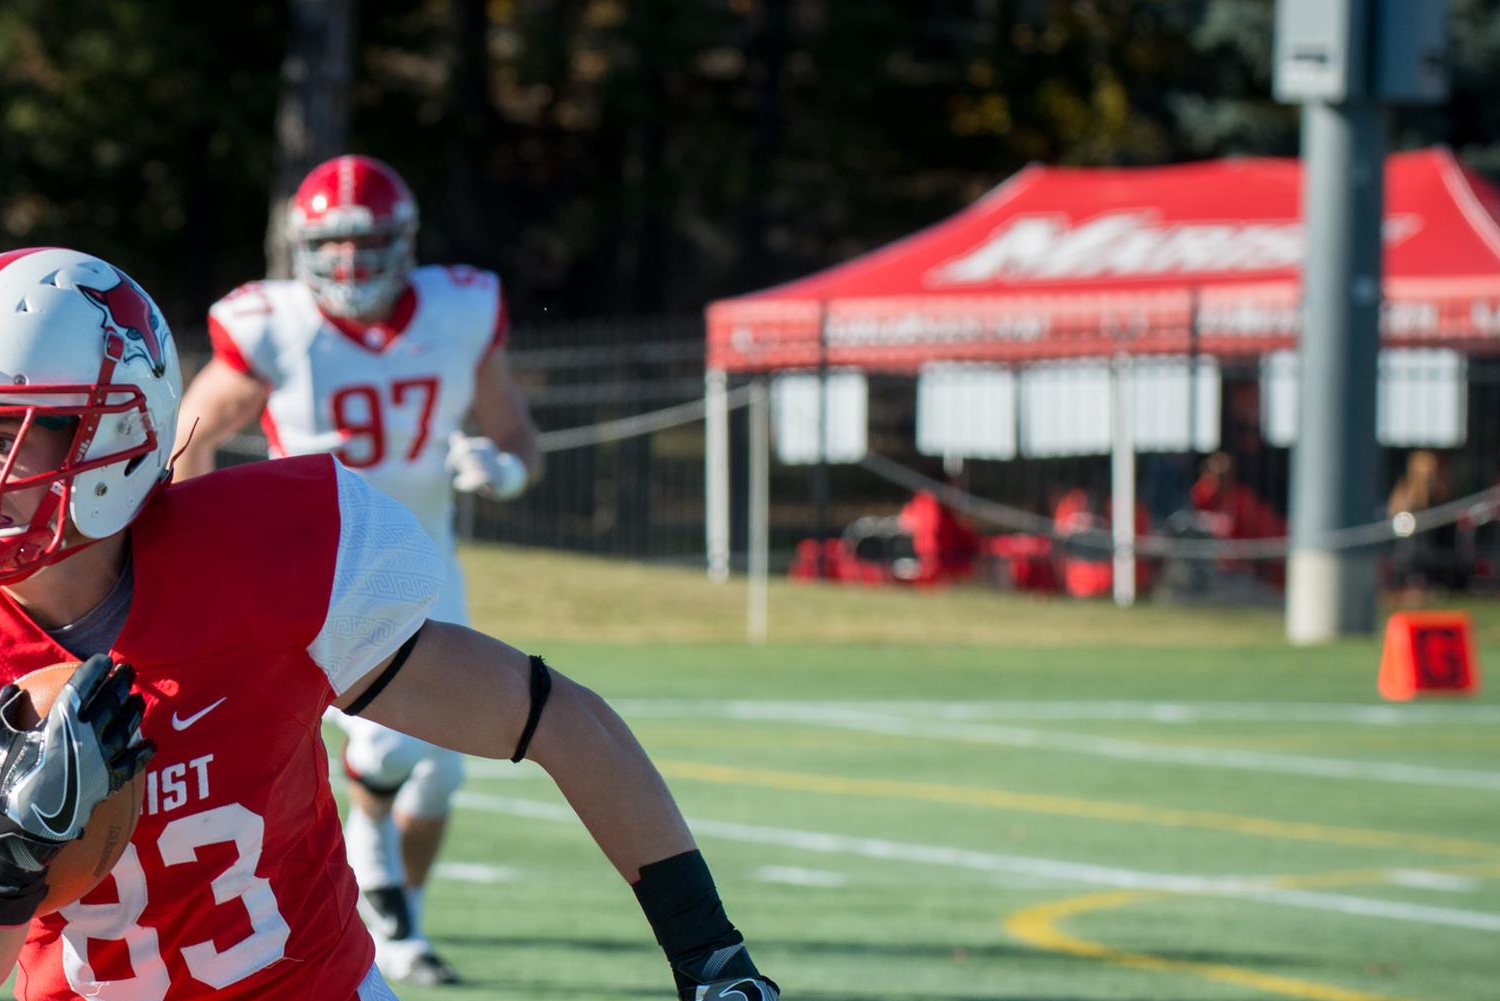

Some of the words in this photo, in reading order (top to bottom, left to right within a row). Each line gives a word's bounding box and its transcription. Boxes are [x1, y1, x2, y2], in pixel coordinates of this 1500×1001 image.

[329, 374, 441, 470] 97
[1416, 627, 1463, 690] G
[139, 753, 214, 816] IST
